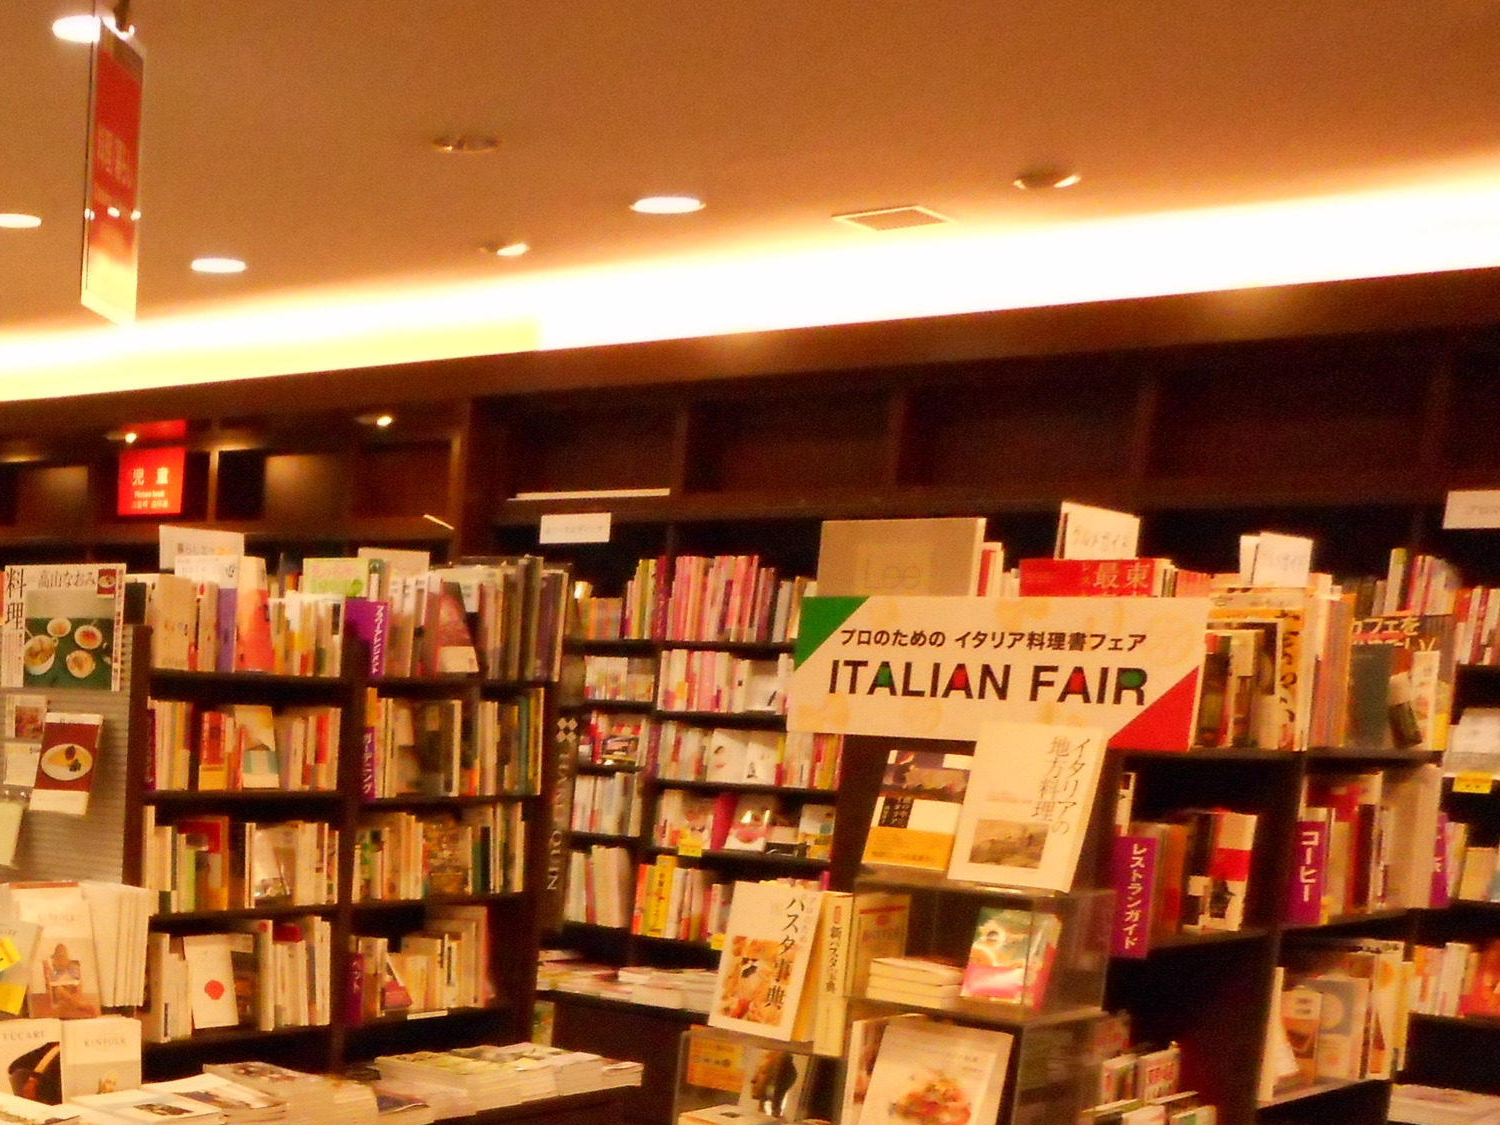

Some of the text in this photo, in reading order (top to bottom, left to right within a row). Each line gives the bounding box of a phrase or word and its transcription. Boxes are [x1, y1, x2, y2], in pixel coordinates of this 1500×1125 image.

[39, 569, 97, 588] 高山なおみ
[840, 628, 1147, 652] プロのための イタリア料理書フェア
[828, 659, 1148, 706] ITALIAN FAIR
[1031, 735, 1071, 822] 地方料理
[1050, 738, 1091, 836] イタリアの
[1299, 831, 1321, 902] コーヒー
[1123, 843, 1148, 949] レストランガイド
[1, 1030, 45, 1041] YUCARI
[83, 1036, 127, 1047] KINFOLK
